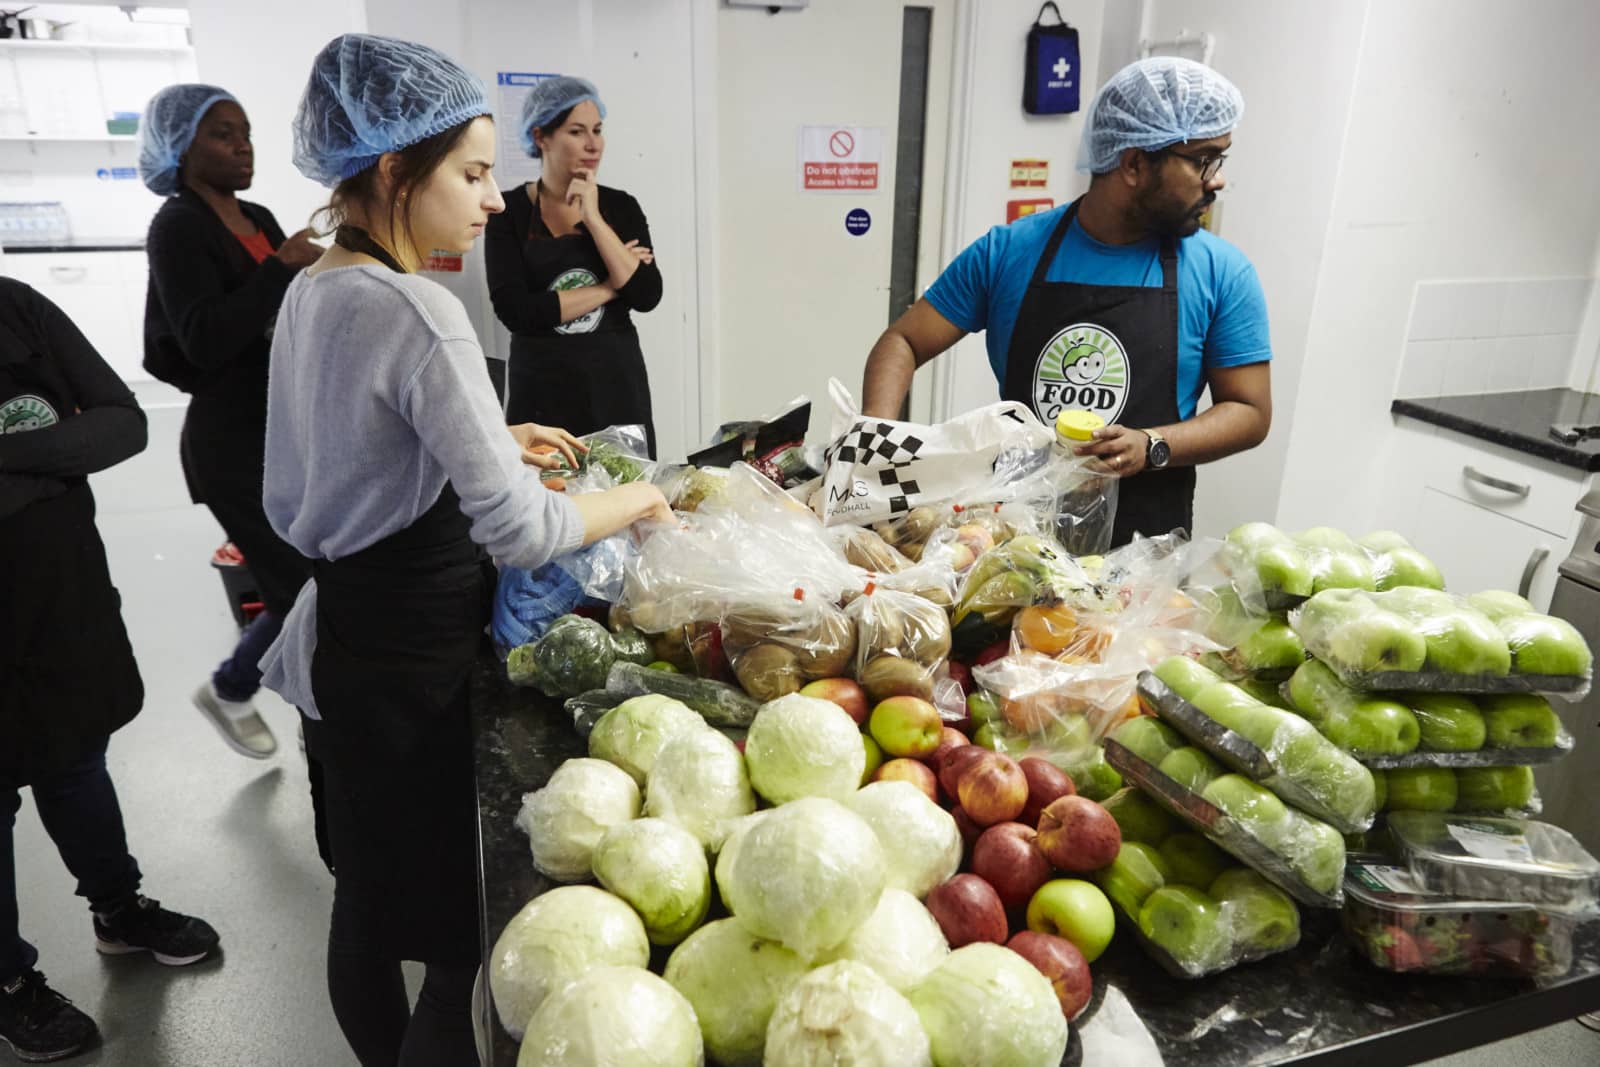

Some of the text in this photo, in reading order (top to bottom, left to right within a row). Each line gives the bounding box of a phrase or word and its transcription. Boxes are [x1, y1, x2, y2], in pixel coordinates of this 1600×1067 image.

[806, 166, 876, 175] Do not obstruct
[1040, 384, 1116, 410] FOOD
